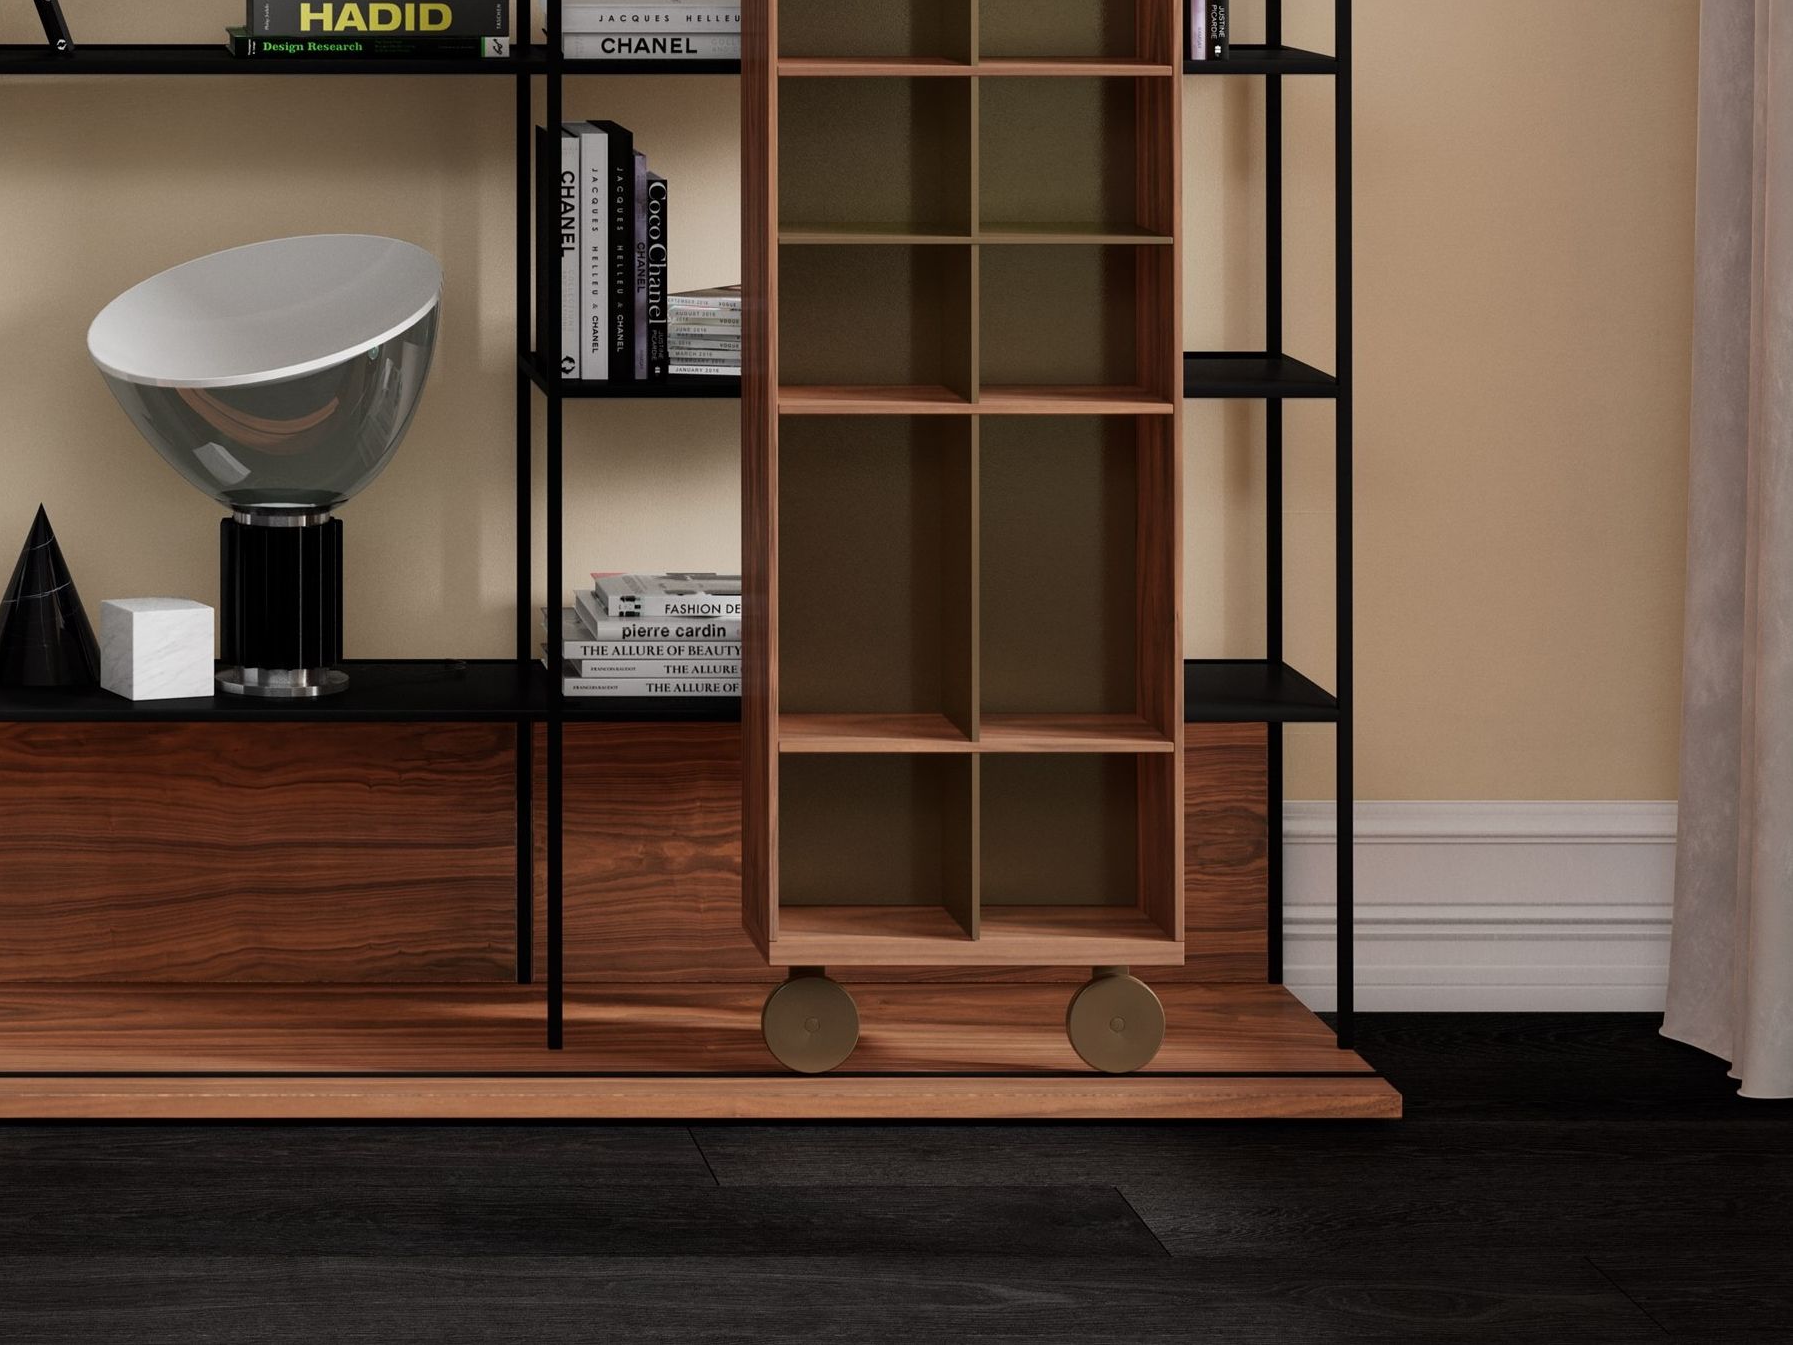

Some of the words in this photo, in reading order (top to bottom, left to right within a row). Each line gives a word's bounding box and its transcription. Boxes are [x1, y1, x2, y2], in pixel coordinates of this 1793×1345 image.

[300, 3, 453, 32] HADID
[263, 41, 304, 53] Design
[307, 41, 363, 53] Research
[601, 37, 697, 54] CHANEL
[591, 167, 599, 232] JACQUES
[591, 246, 599, 296] HELLEU
[591, 315, 599, 354] CHANEL
[664, 604, 721, 614] FASHION
[622, 624, 670, 639] pierre
[675, 624, 726, 637] cardin
[580, 645, 609, 656] THE
[611, 645, 664, 656] ALLURE
[667, 645, 685, 656] OF
[688, 645, 741, 656] BEAUTY
